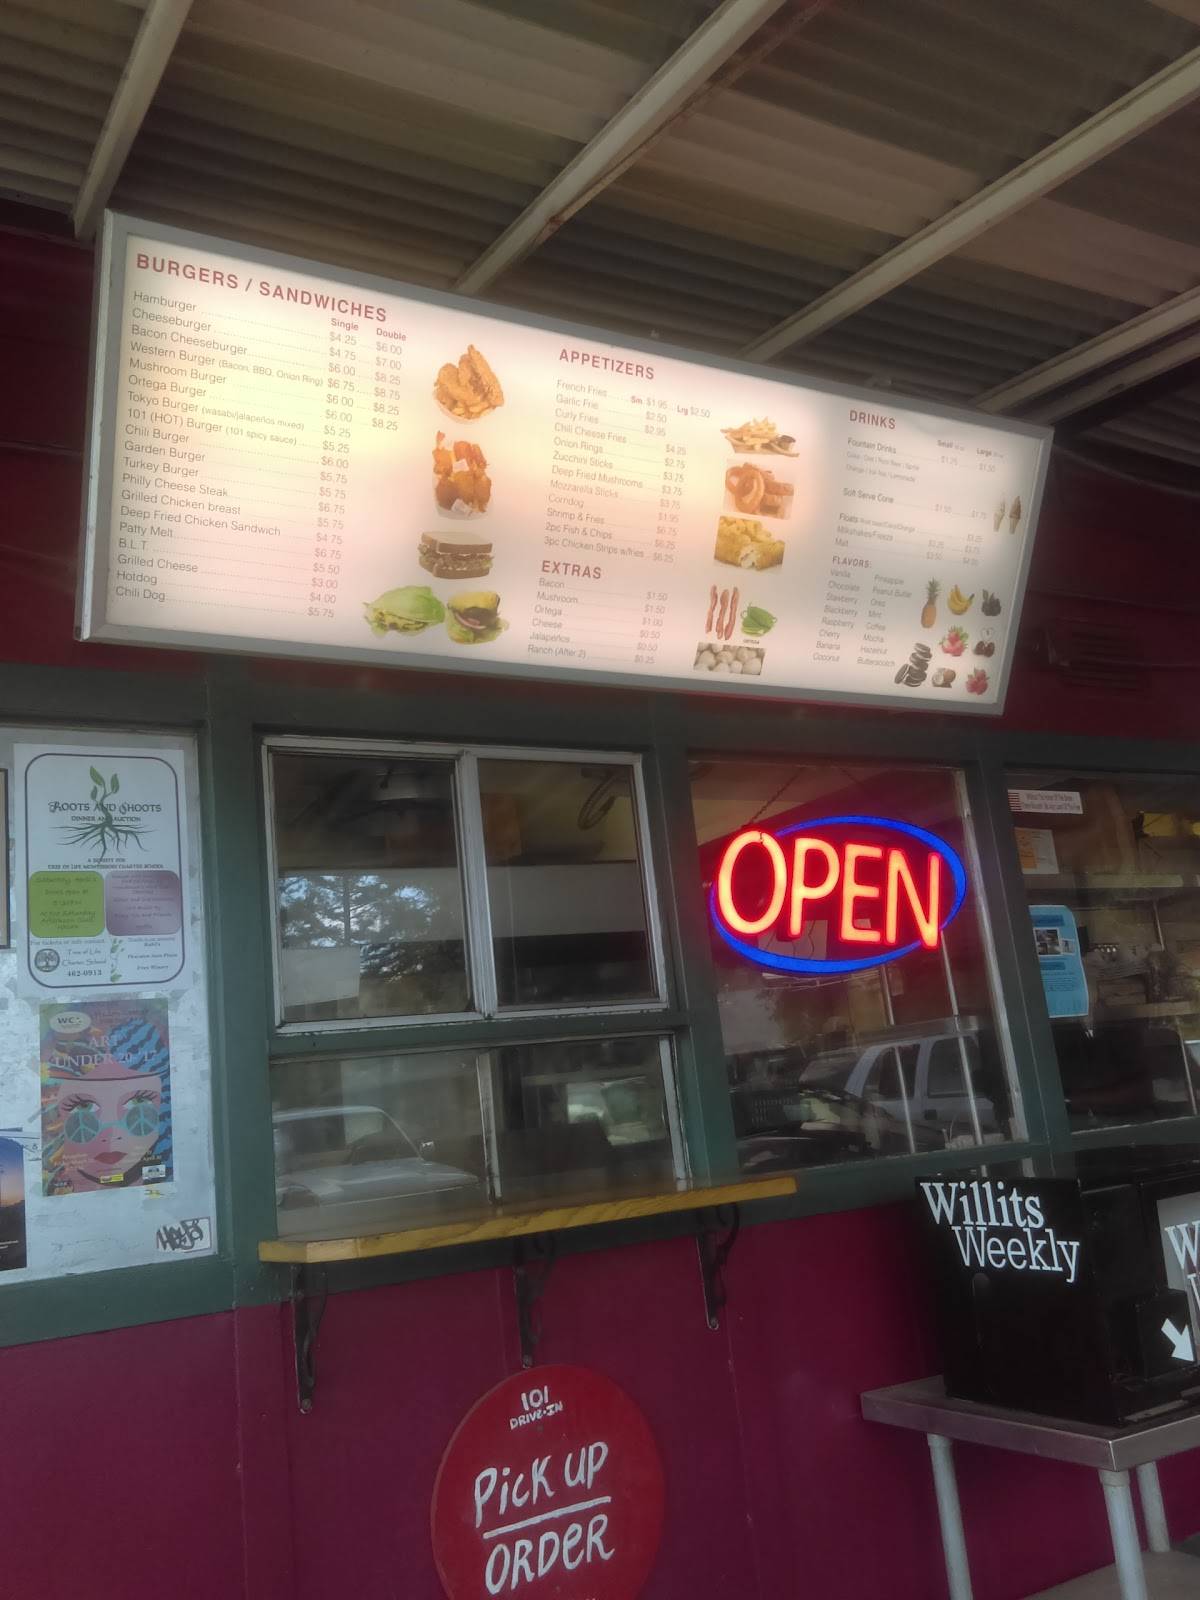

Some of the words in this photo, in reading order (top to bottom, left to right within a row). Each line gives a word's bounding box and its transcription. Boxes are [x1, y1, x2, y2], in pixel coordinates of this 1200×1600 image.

[137, 253, 239, 290] BURGERS
[259, 281, 387, 322] SANDWICHES
[133, 290, 197, 312] Hamburger
[132, 307, 212, 332] Cheeseburger
[330, 317, 359, 331] Single
[376, 327, 407, 342] Double
[131, 324, 168, 340] Bacon
[170, 331, 248, 355] Cheeseburger
[129, 358, 187, 377] Mushroom
[190, 368, 227, 385] Burger
[130, 341, 176, 358] Western
[179, 349, 216, 366] Burger
[276, 369, 301, 381] Onion
[302, 374, 324, 387] Ring)
[559, 348, 655, 381] APPETIZERS
[128, 374, 167, 392] Ortega
[170, 381, 207, 398] Burger
[556, 379, 586, 394] French
[587, 384, 608, 398] Fries
[128, 390, 160, 407] Tokyo
[162, 396, 199, 413] Burger
[555, 393, 581, 407] Garlic
[554, 407, 577, 422] Curly
[579, 412, 599, 425] Fries
[849, 409, 897, 431] DRINKS
[125, 423, 150, 436] Chili
[152, 428, 190, 444] Burger
[128, 408, 147, 420] 101
[150, 411, 184, 427] (HOT)
[186, 417, 223, 433] Burger
[246, 430, 268, 442] spicy
[269, 433, 297, 447] sauce)
[554, 422, 573, 435] Chili
[574, 425, 606, 440] Cheese
[608, 431, 627, 444] Fries
[124, 440, 166, 456] Garden
[169, 447, 207, 463] Burger
[553, 436, 579, 450] Onion
[580, 441, 604, 454] Rings
[847, 437, 876, 451] Fountain
[876, 441, 897, 455] Drinks
[937, 439, 953, 449] Small
[976, 447, 992, 457] Large
[123, 456, 160, 473] Turkey
[162, 462, 200, 478] Burger
[552, 450, 588, 465] Zucchini
[590, 456, 614, 470] Sticks
[122, 473, 152, 489] Philly
[154, 477, 196, 493] Cheese
[199, 484, 229, 497] Steak
[551, 464, 574, 478] Deep
[576, 468, 596, 481] Fried
[598, 472, 644, 489] Mushrooms
[550, 479, 593, 495] Mozzarella
[595, 485, 619, 499] Sticks
[842, 488, 856, 498] Soft
[857, 489, 876, 501] Serve
[877, 493, 895, 504] Cone
[121, 489, 158, 504] Grilled
[160, 494, 205, 511] Chicken
[208, 501, 241, 516] breast
[548, 493, 585, 509] Corndog
[120, 505, 151, 521] Deep
[153, 510, 182, 523] Fried
[184, 514, 229, 529] Chicken
[230, 520, 281, 536] Sandwich
[546, 507, 576, 522] Shrimp
[577, 512, 584, 521] &
[585, 513, 605, 526] Fries
[120, 521, 148, 537] Patty
[150, 526, 173, 538] Melt
[545, 522, 561, 533] 2pc
[563, 524, 580, 536] Fish
[581, 526, 588, 536] &
[589, 527, 613, 540] Chips
[543, 535, 560, 548] 3pc
[561, 538, 594, 552] Chicken
[596, 542, 618, 555] Strips
[117, 553, 154, 569] Grilled
[157, 558, 199, 573] Cheese
[541, 560, 602, 580] EXTRAS
[832, 555, 872, 569] FLAVORS:
[116, 570, 158, 586] Hotdog
[538, 577, 566, 590] Bacon
[115, 585, 140, 598] Chili
[143, 589, 166, 603] Dog
[536, 591, 579, 604] Mushroom
[534, 604, 563, 617] Ortega
[532, 618, 563, 630] Cheese
[527, 644, 554, 655] Ranch
[717, 829, 940, 949] OPEN
[920, 1180, 1045, 1229] Willits
[951, 1226, 1080, 1283] Weekly
[521, 1385, 549, 1412] 101
[564, 1441, 609, 1490] UP
